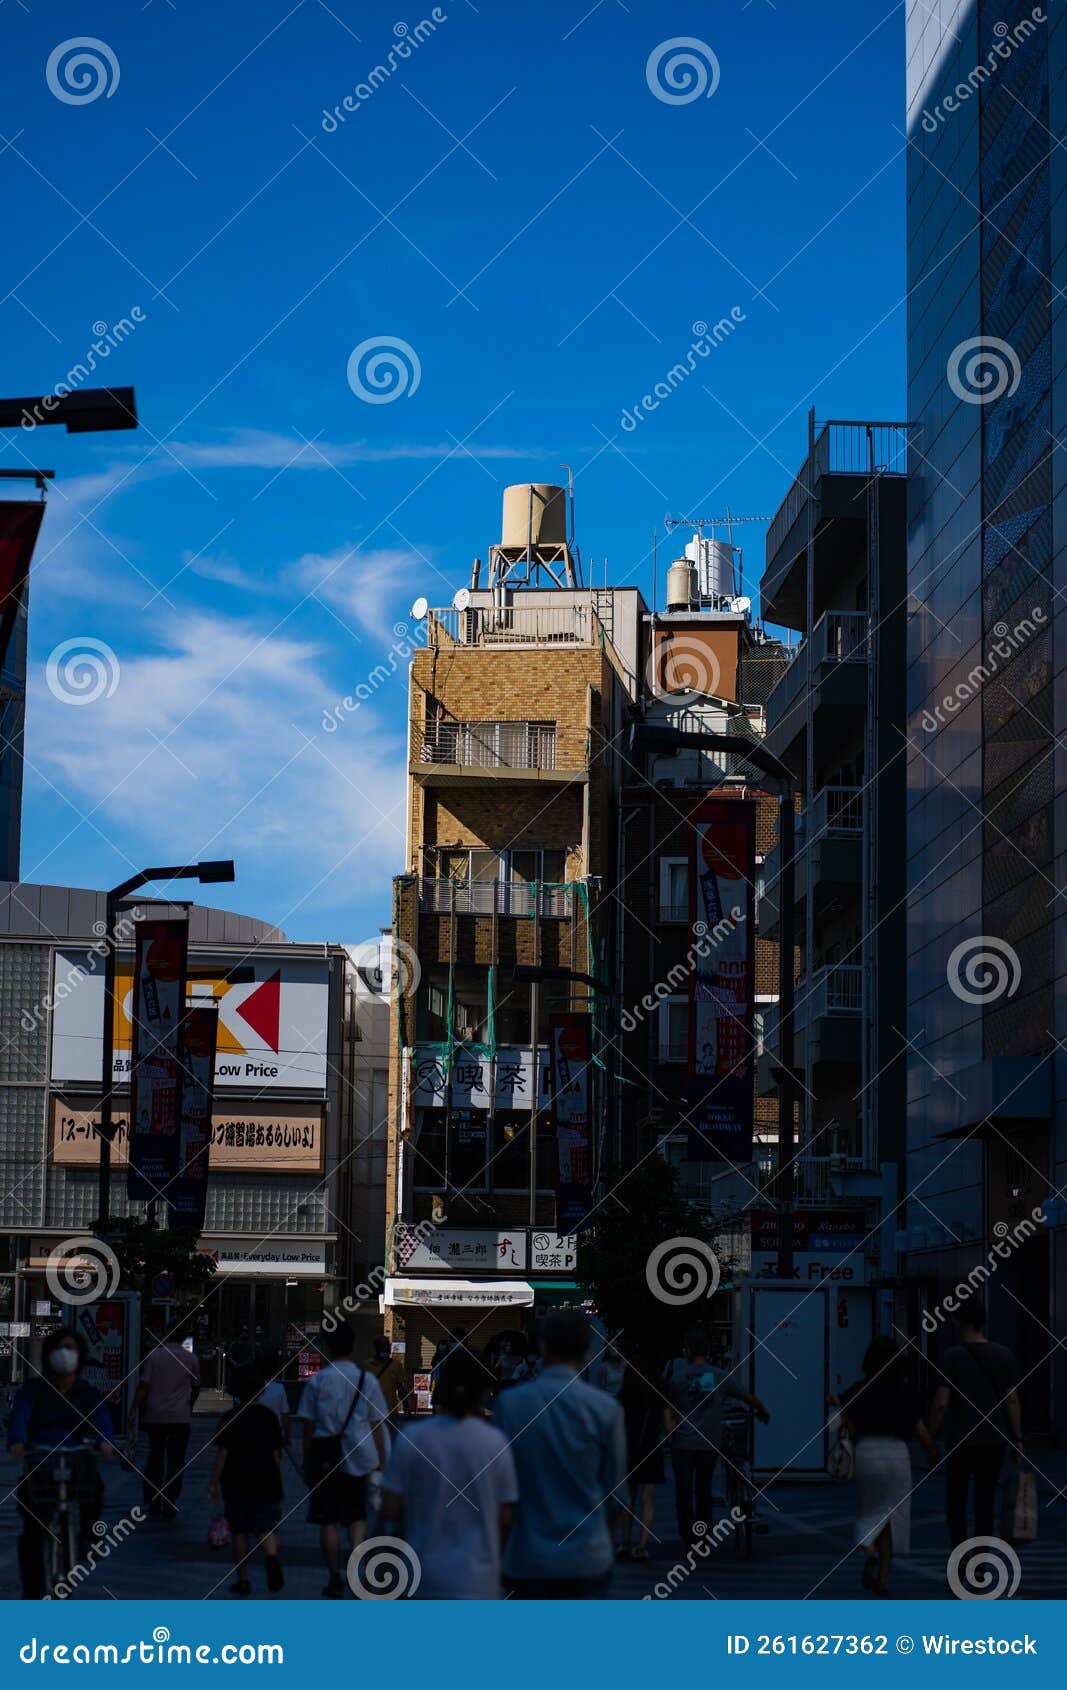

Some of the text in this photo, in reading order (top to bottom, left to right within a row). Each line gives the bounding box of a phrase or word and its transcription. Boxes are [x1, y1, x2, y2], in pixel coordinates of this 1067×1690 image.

[245, 1063, 278, 1078] Price
[282, 1253, 299, 1261] Low
[301, 1253, 321, 1262] Price
[492, 1238, 520, 1266] すし
[536, 1253, 573, 1267] 喫茶 P
[807, 1262, 854, 1281] Free
